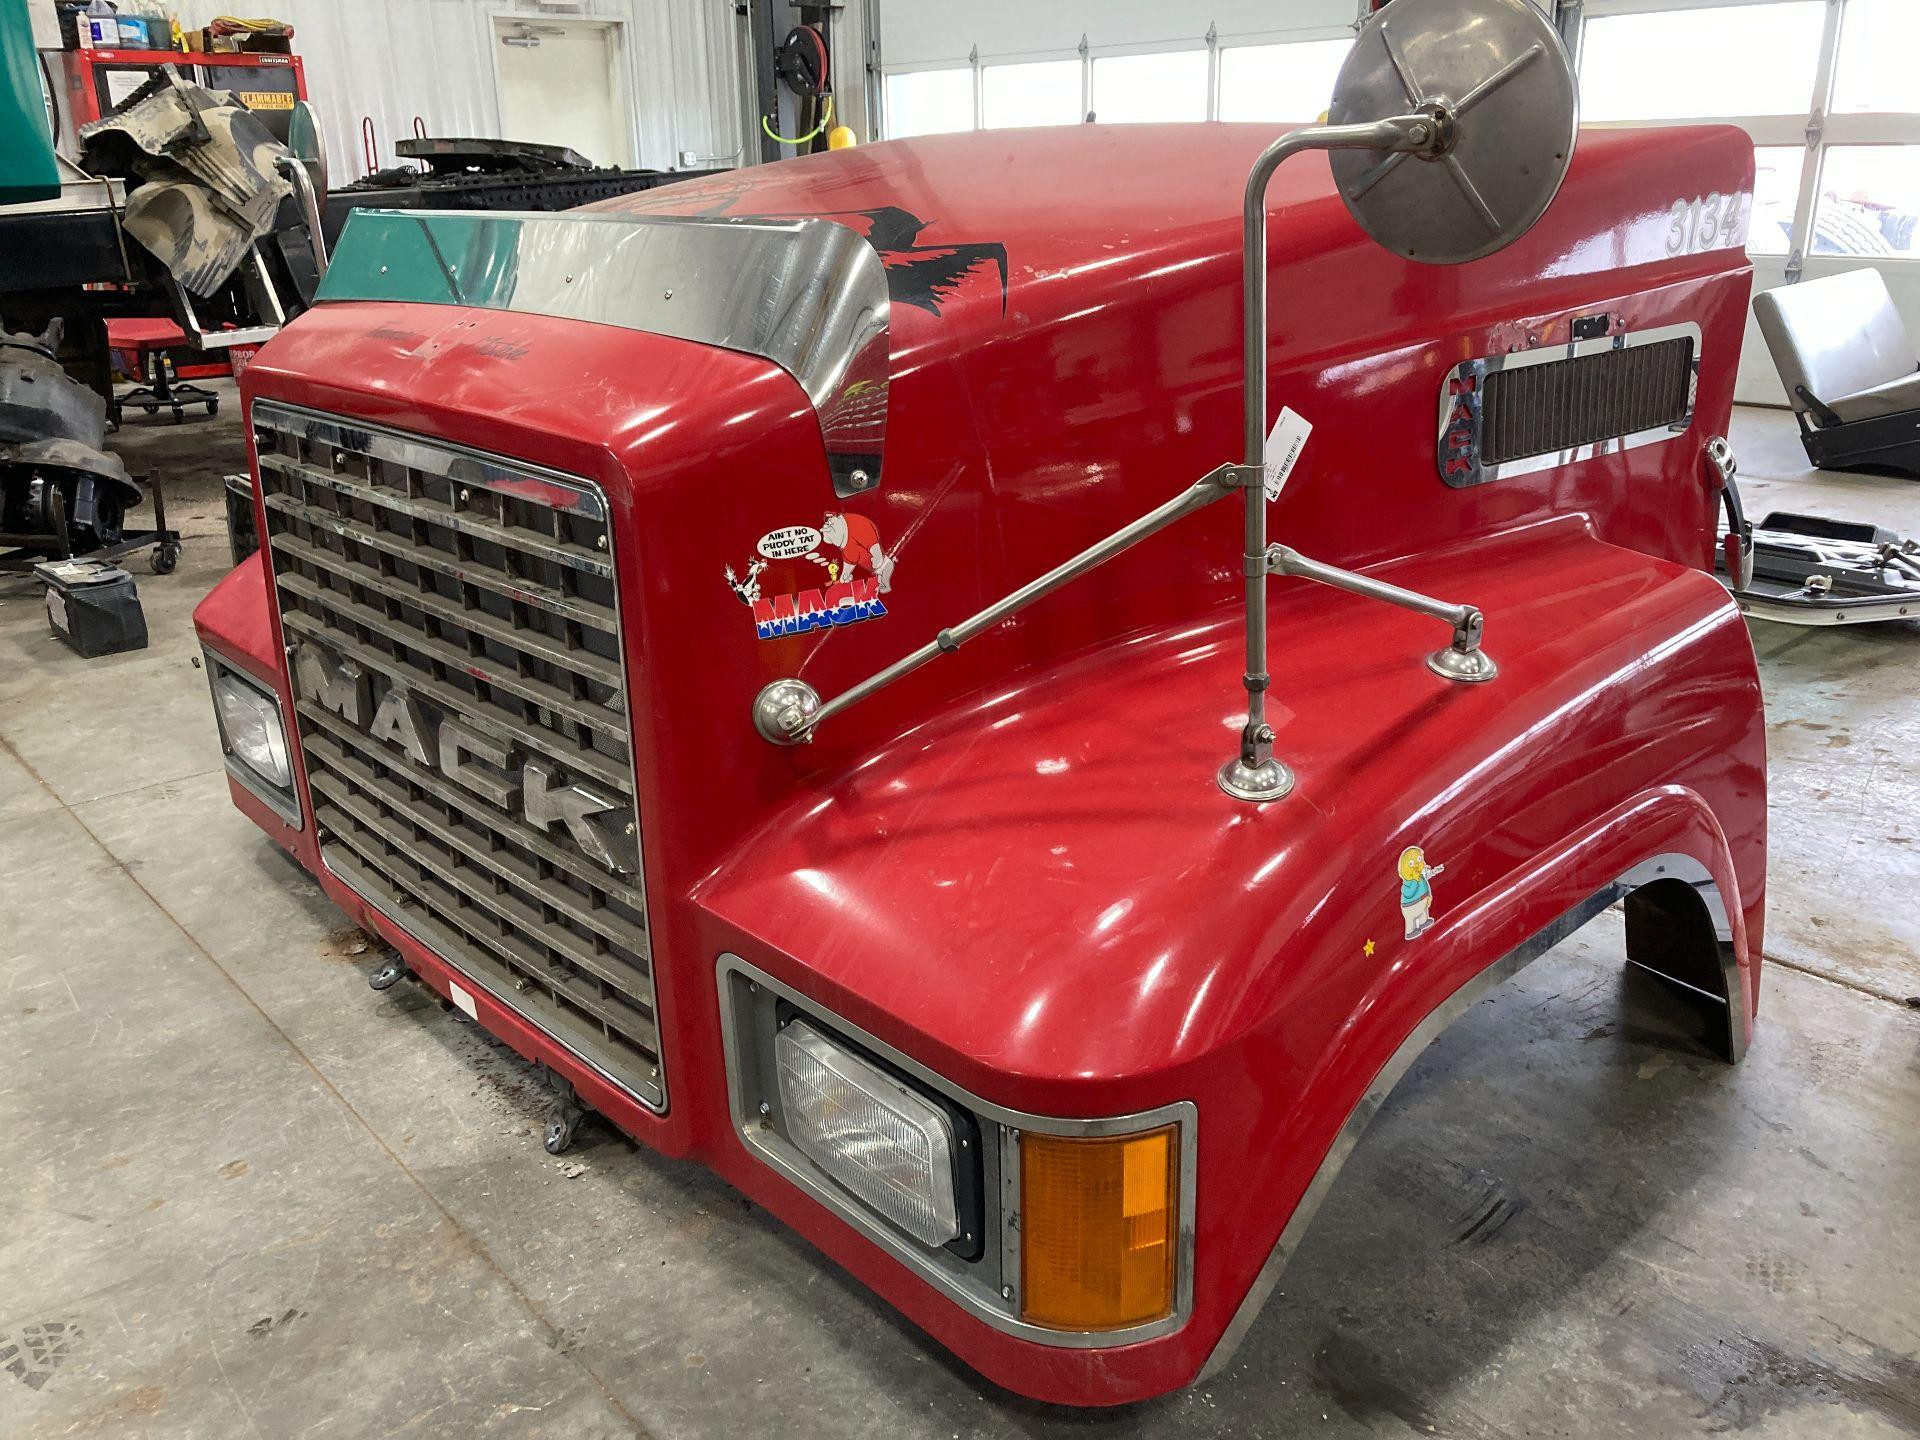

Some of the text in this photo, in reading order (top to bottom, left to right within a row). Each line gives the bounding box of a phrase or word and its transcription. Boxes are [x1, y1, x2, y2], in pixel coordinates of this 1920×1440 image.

[242, 94, 291, 104] FLAMMABLE
[1665, 191, 1743, 258] 3134
[1445, 374, 1477, 475] MACK
[763, 534, 815, 551] PUDDY TAT
[768, 528, 808, 541] AIN'T NO
[772, 545, 809, 558] IN HERE
[752, 577, 888, 640] MACK
[297, 642, 628, 874] MACK
